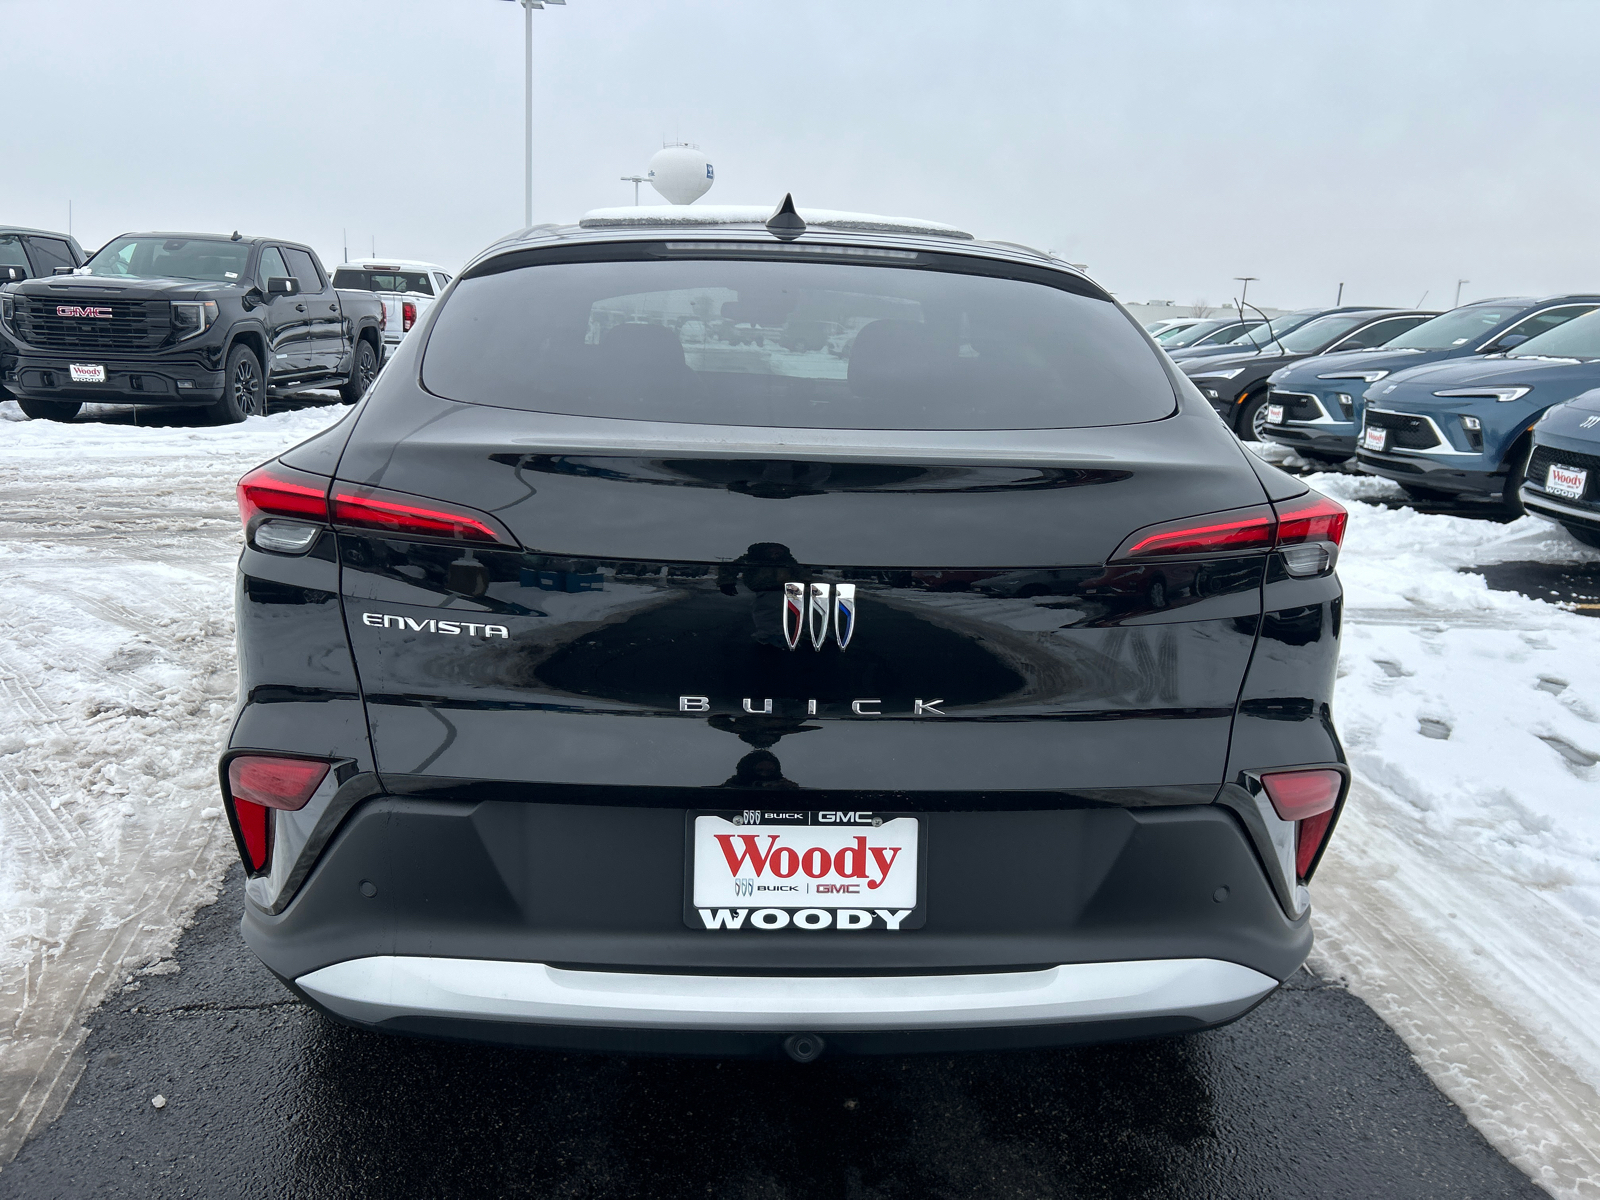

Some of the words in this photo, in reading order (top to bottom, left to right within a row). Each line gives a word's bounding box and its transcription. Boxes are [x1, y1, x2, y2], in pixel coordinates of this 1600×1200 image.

[57, 306, 113, 318] GMC
[73, 367, 102, 377] Woody
[1553, 470, 1584, 489] Woody
[1545, 485, 1581, 499] WOODY
[362, 611, 510, 639] ENVISTA
[679, 696, 945, 715] BUICK
[818, 811, 873, 823] GMC
[713, 834, 902, 890] Woody
[816, 883, 860, 894] GMC
[698, 908, 913, 930] WOODY
